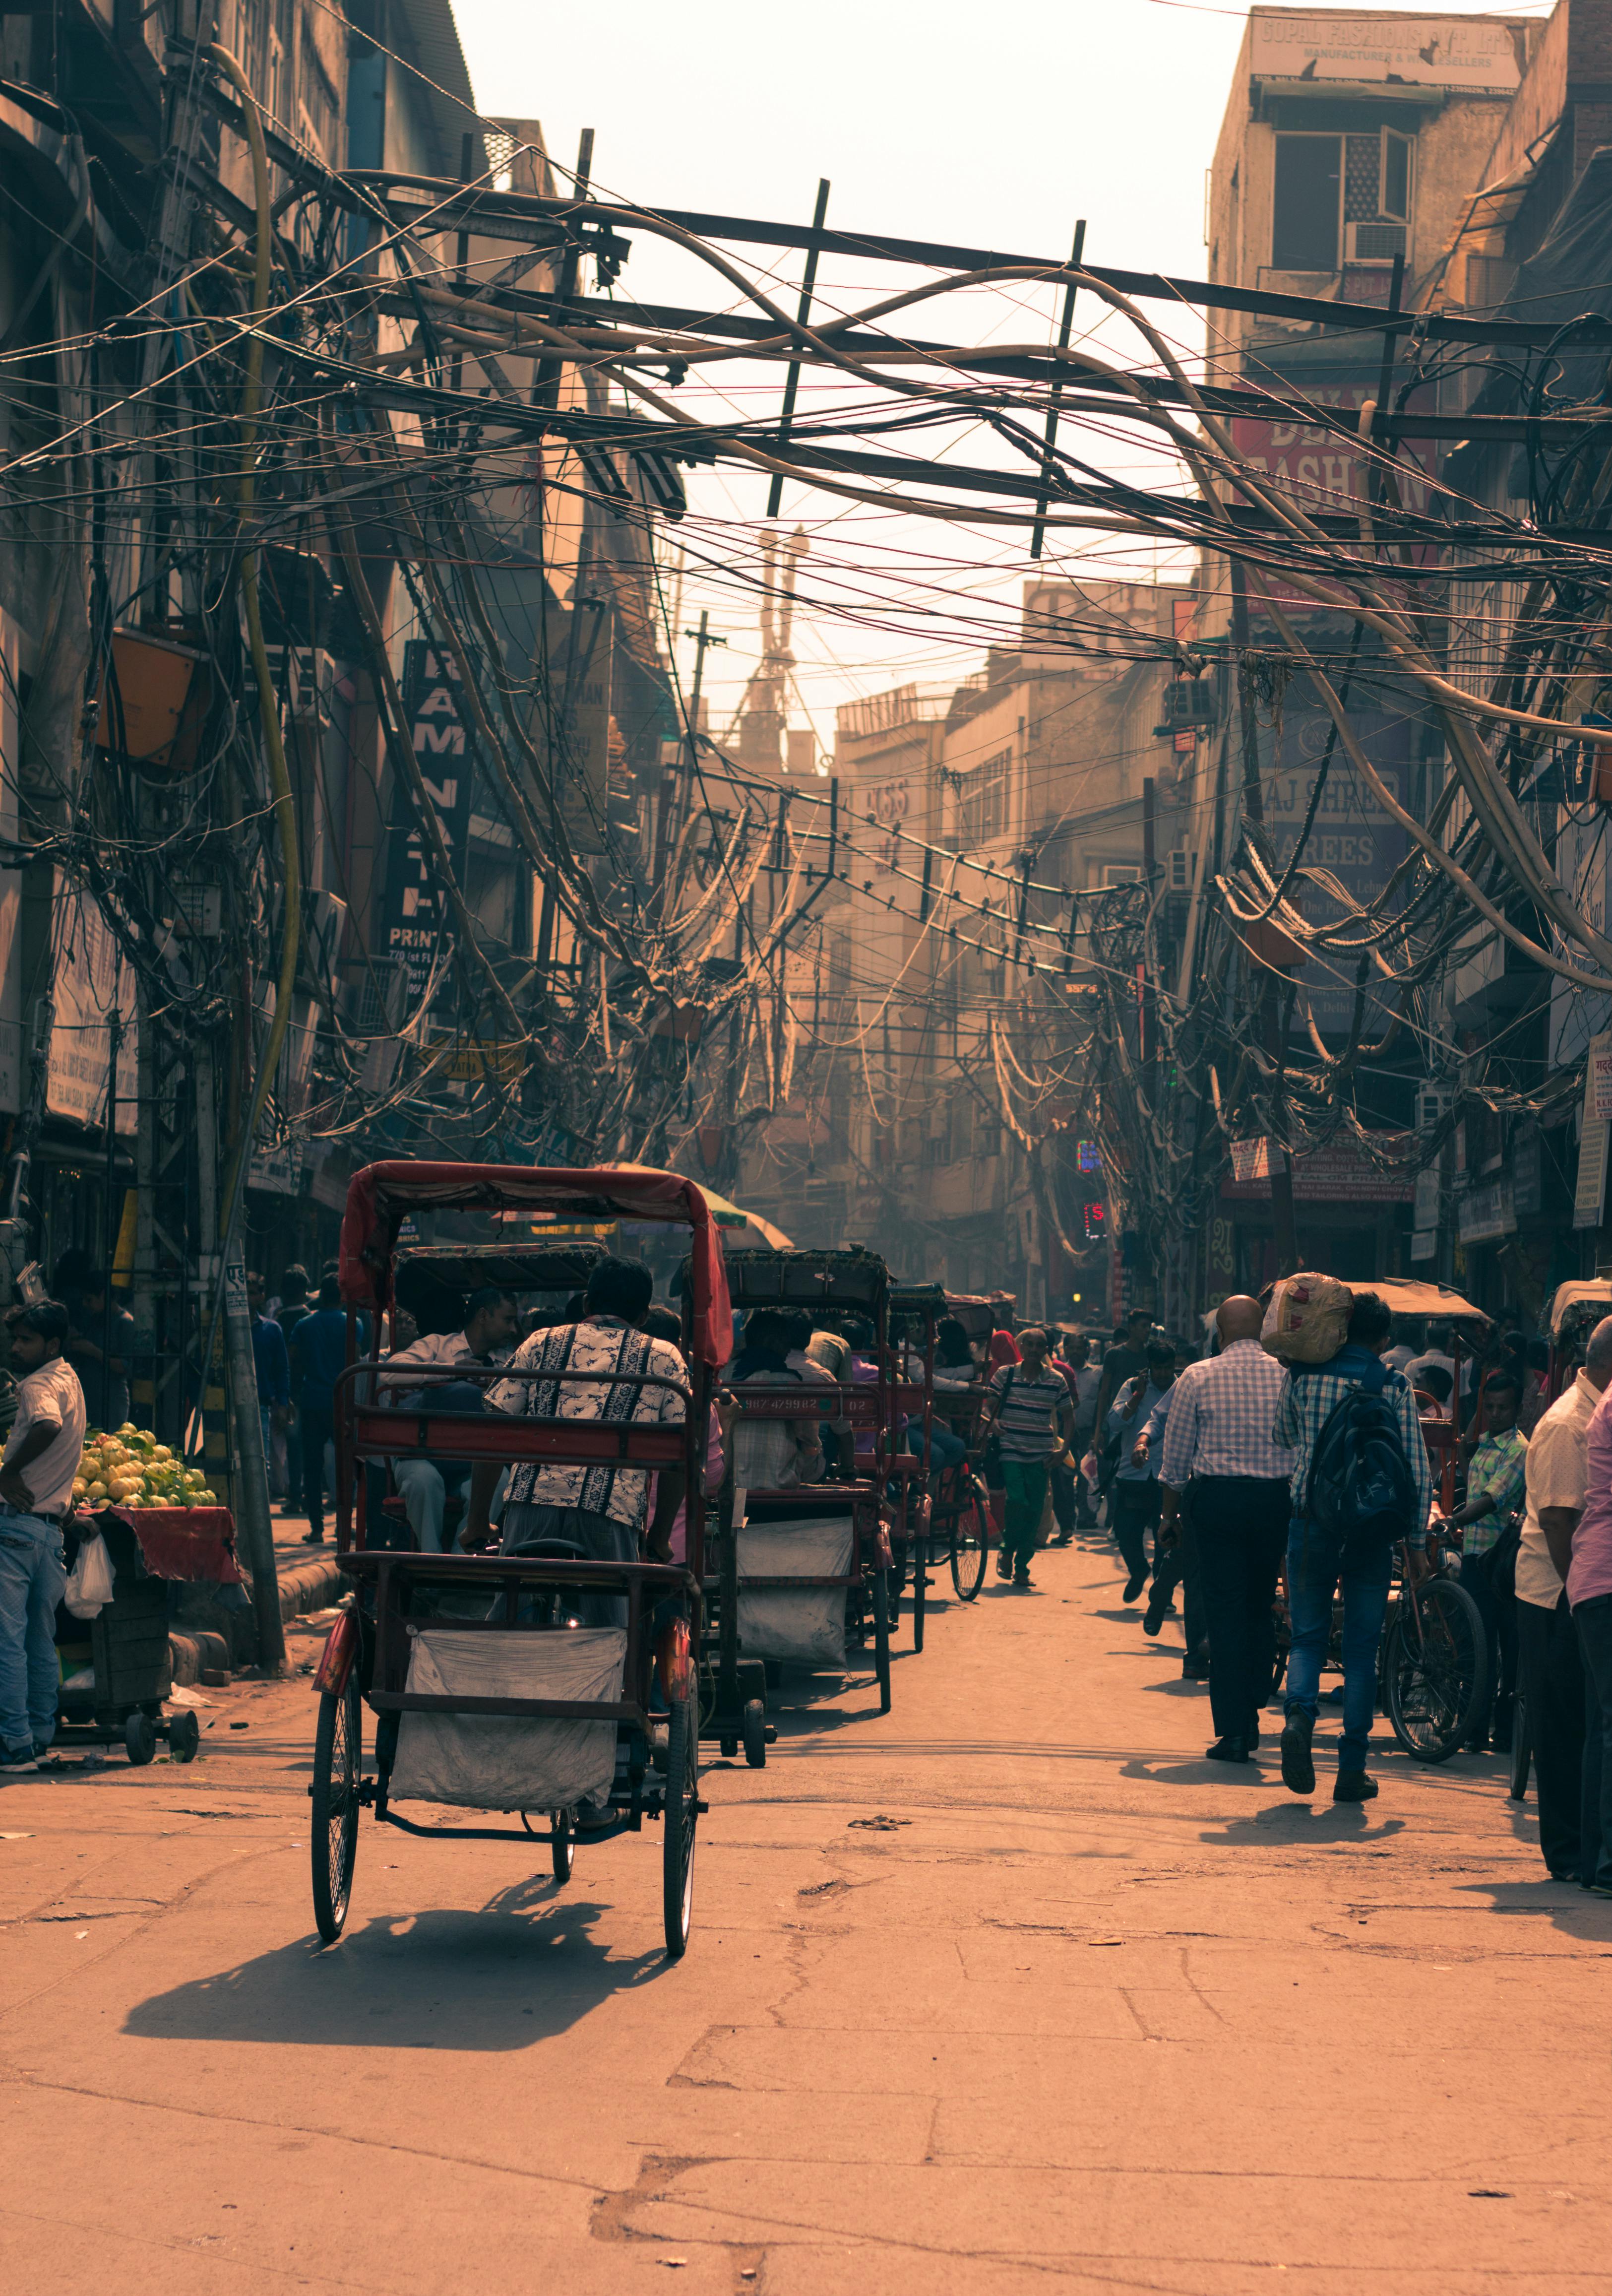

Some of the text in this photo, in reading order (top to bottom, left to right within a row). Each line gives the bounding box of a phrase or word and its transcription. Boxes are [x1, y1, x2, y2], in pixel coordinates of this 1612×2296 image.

[1261, 19, 1321, 45] GOPAL
[1326, 21, 1422, 50] FASHIONS
[1303, 48, 1392, 62] MANUFACTURER
[1406, 54, 1492, 68] WHLESELLERS
[1263, 778, 1298, 813] AJ
[1273, 834, 1374, 866] AREES
[1310, 1164, 1353, 1172] WHOLESALE
